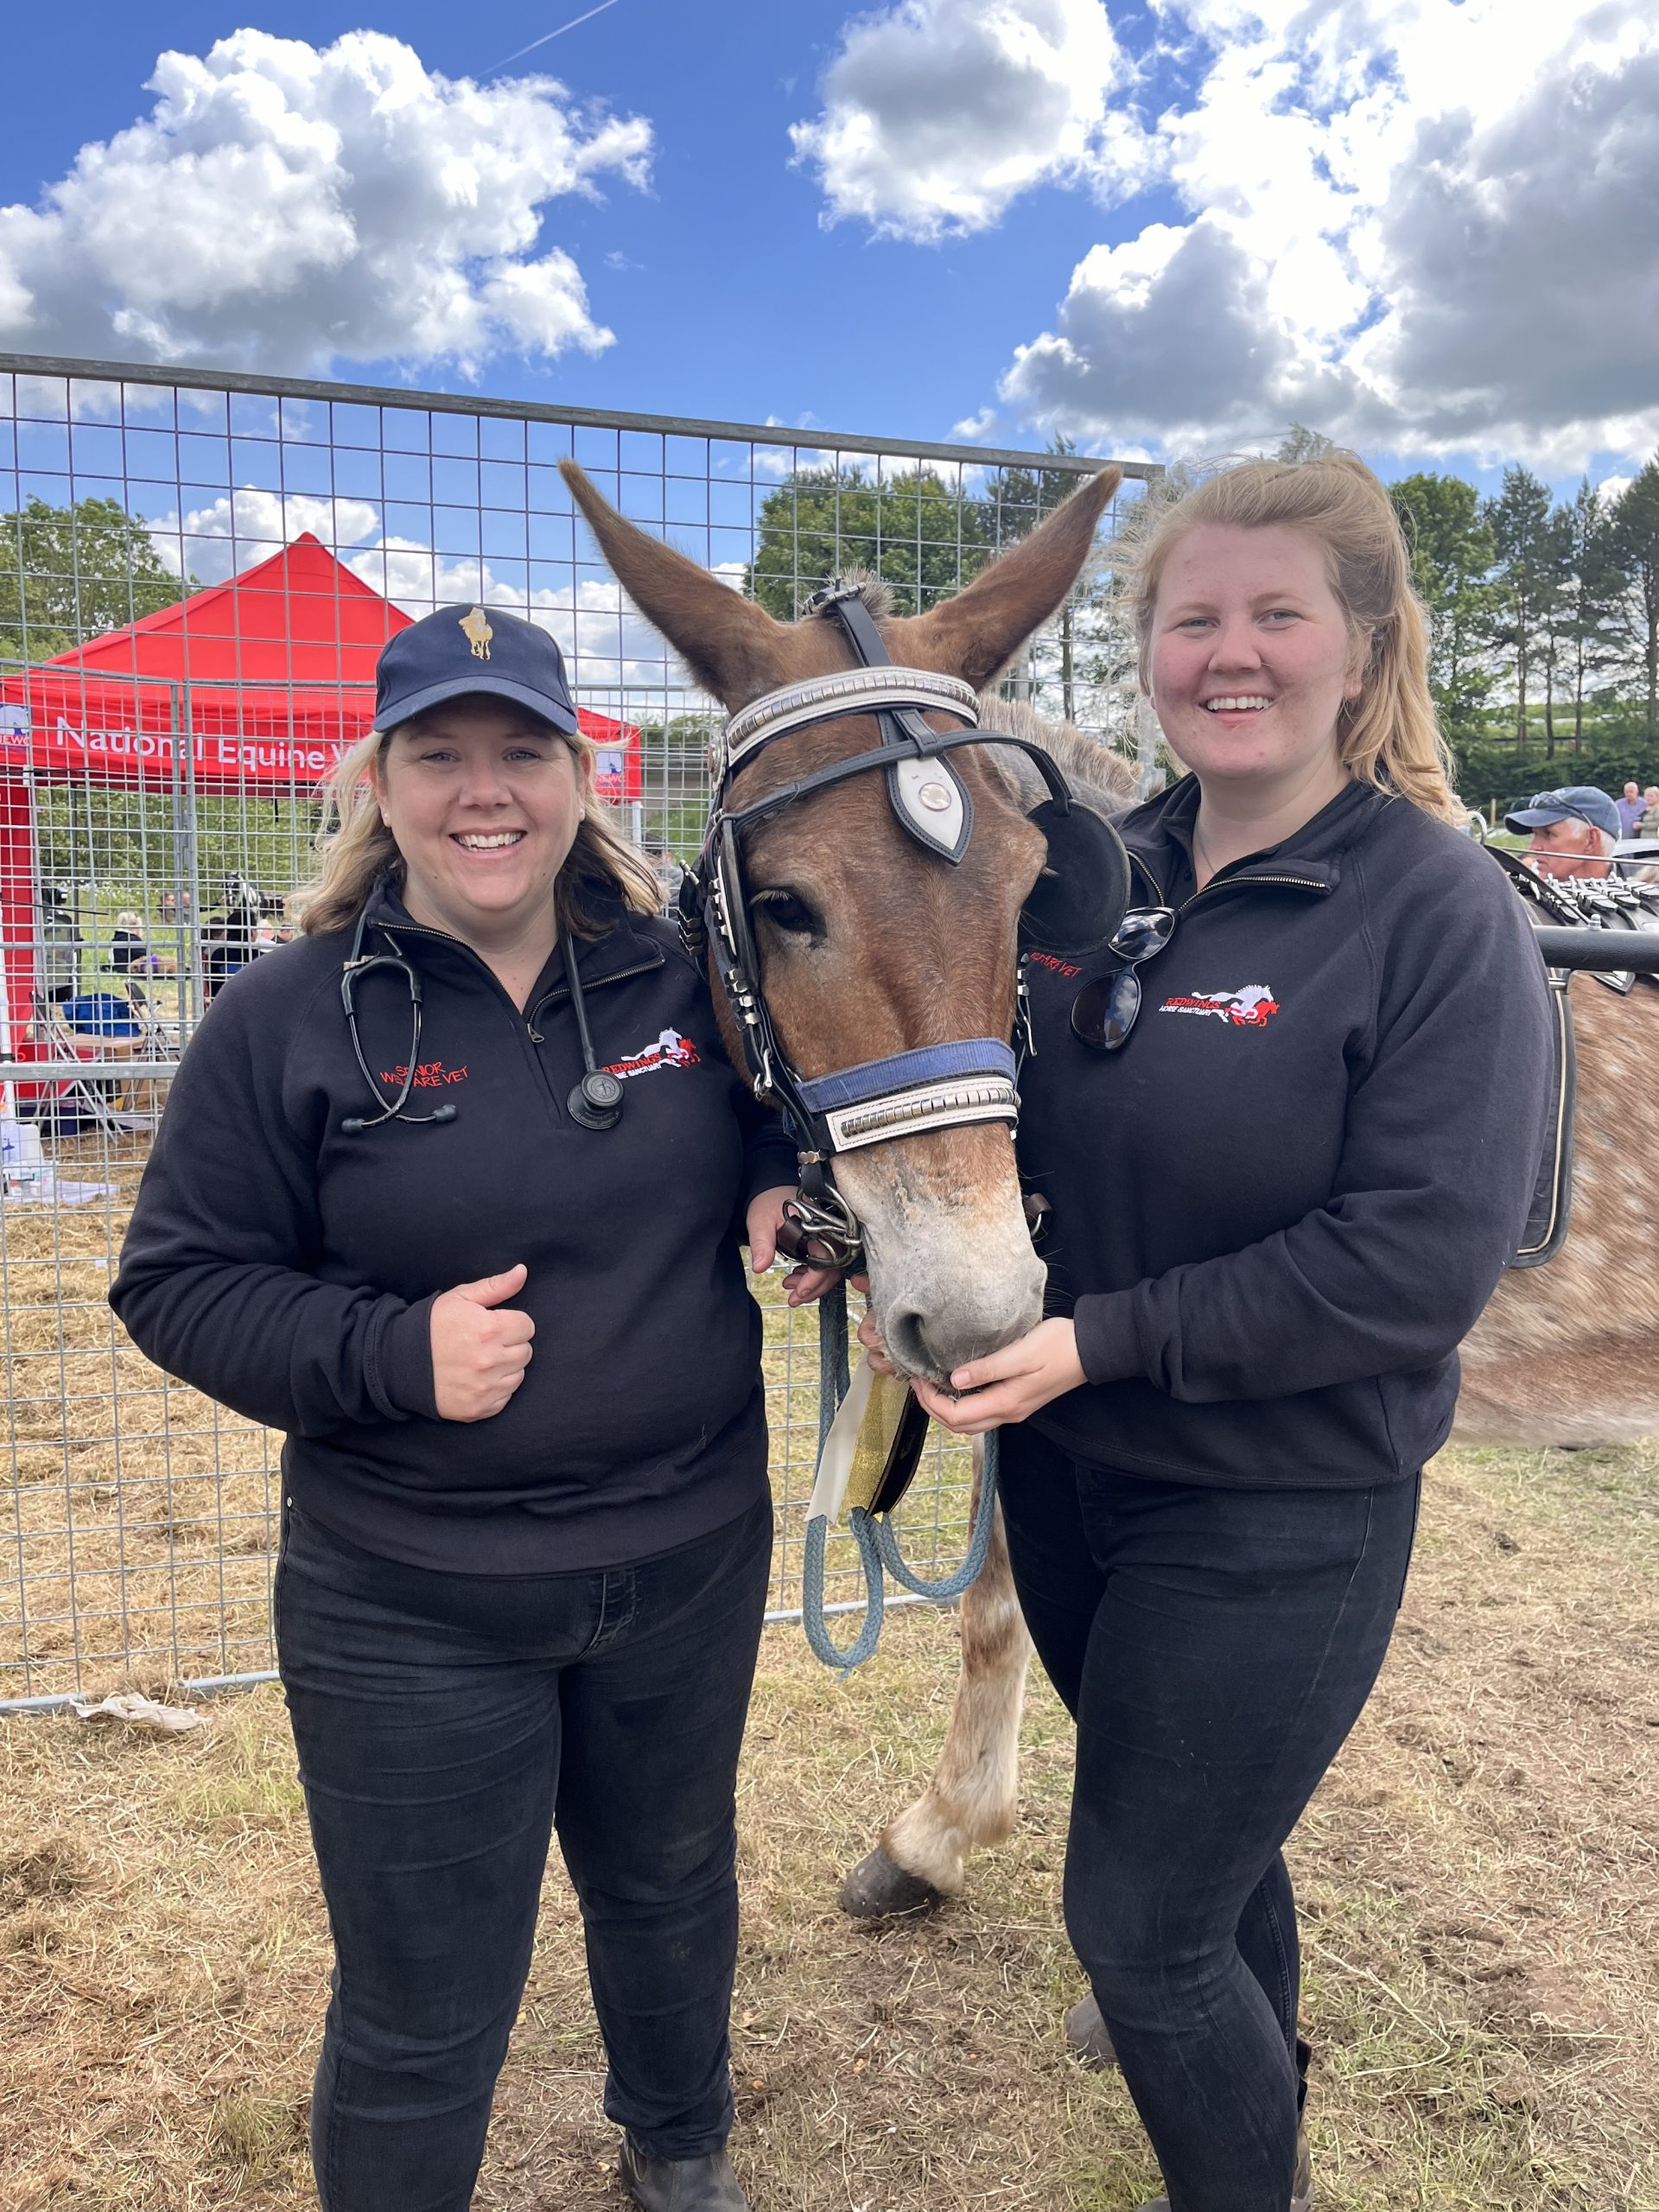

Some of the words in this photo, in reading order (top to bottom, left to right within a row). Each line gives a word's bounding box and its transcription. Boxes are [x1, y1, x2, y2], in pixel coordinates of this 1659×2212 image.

[218, 736, 326, 772] Equine
[1165, 997, 1221, 1009] REDWINGS
[442, 1065, 468, 1084] VET
